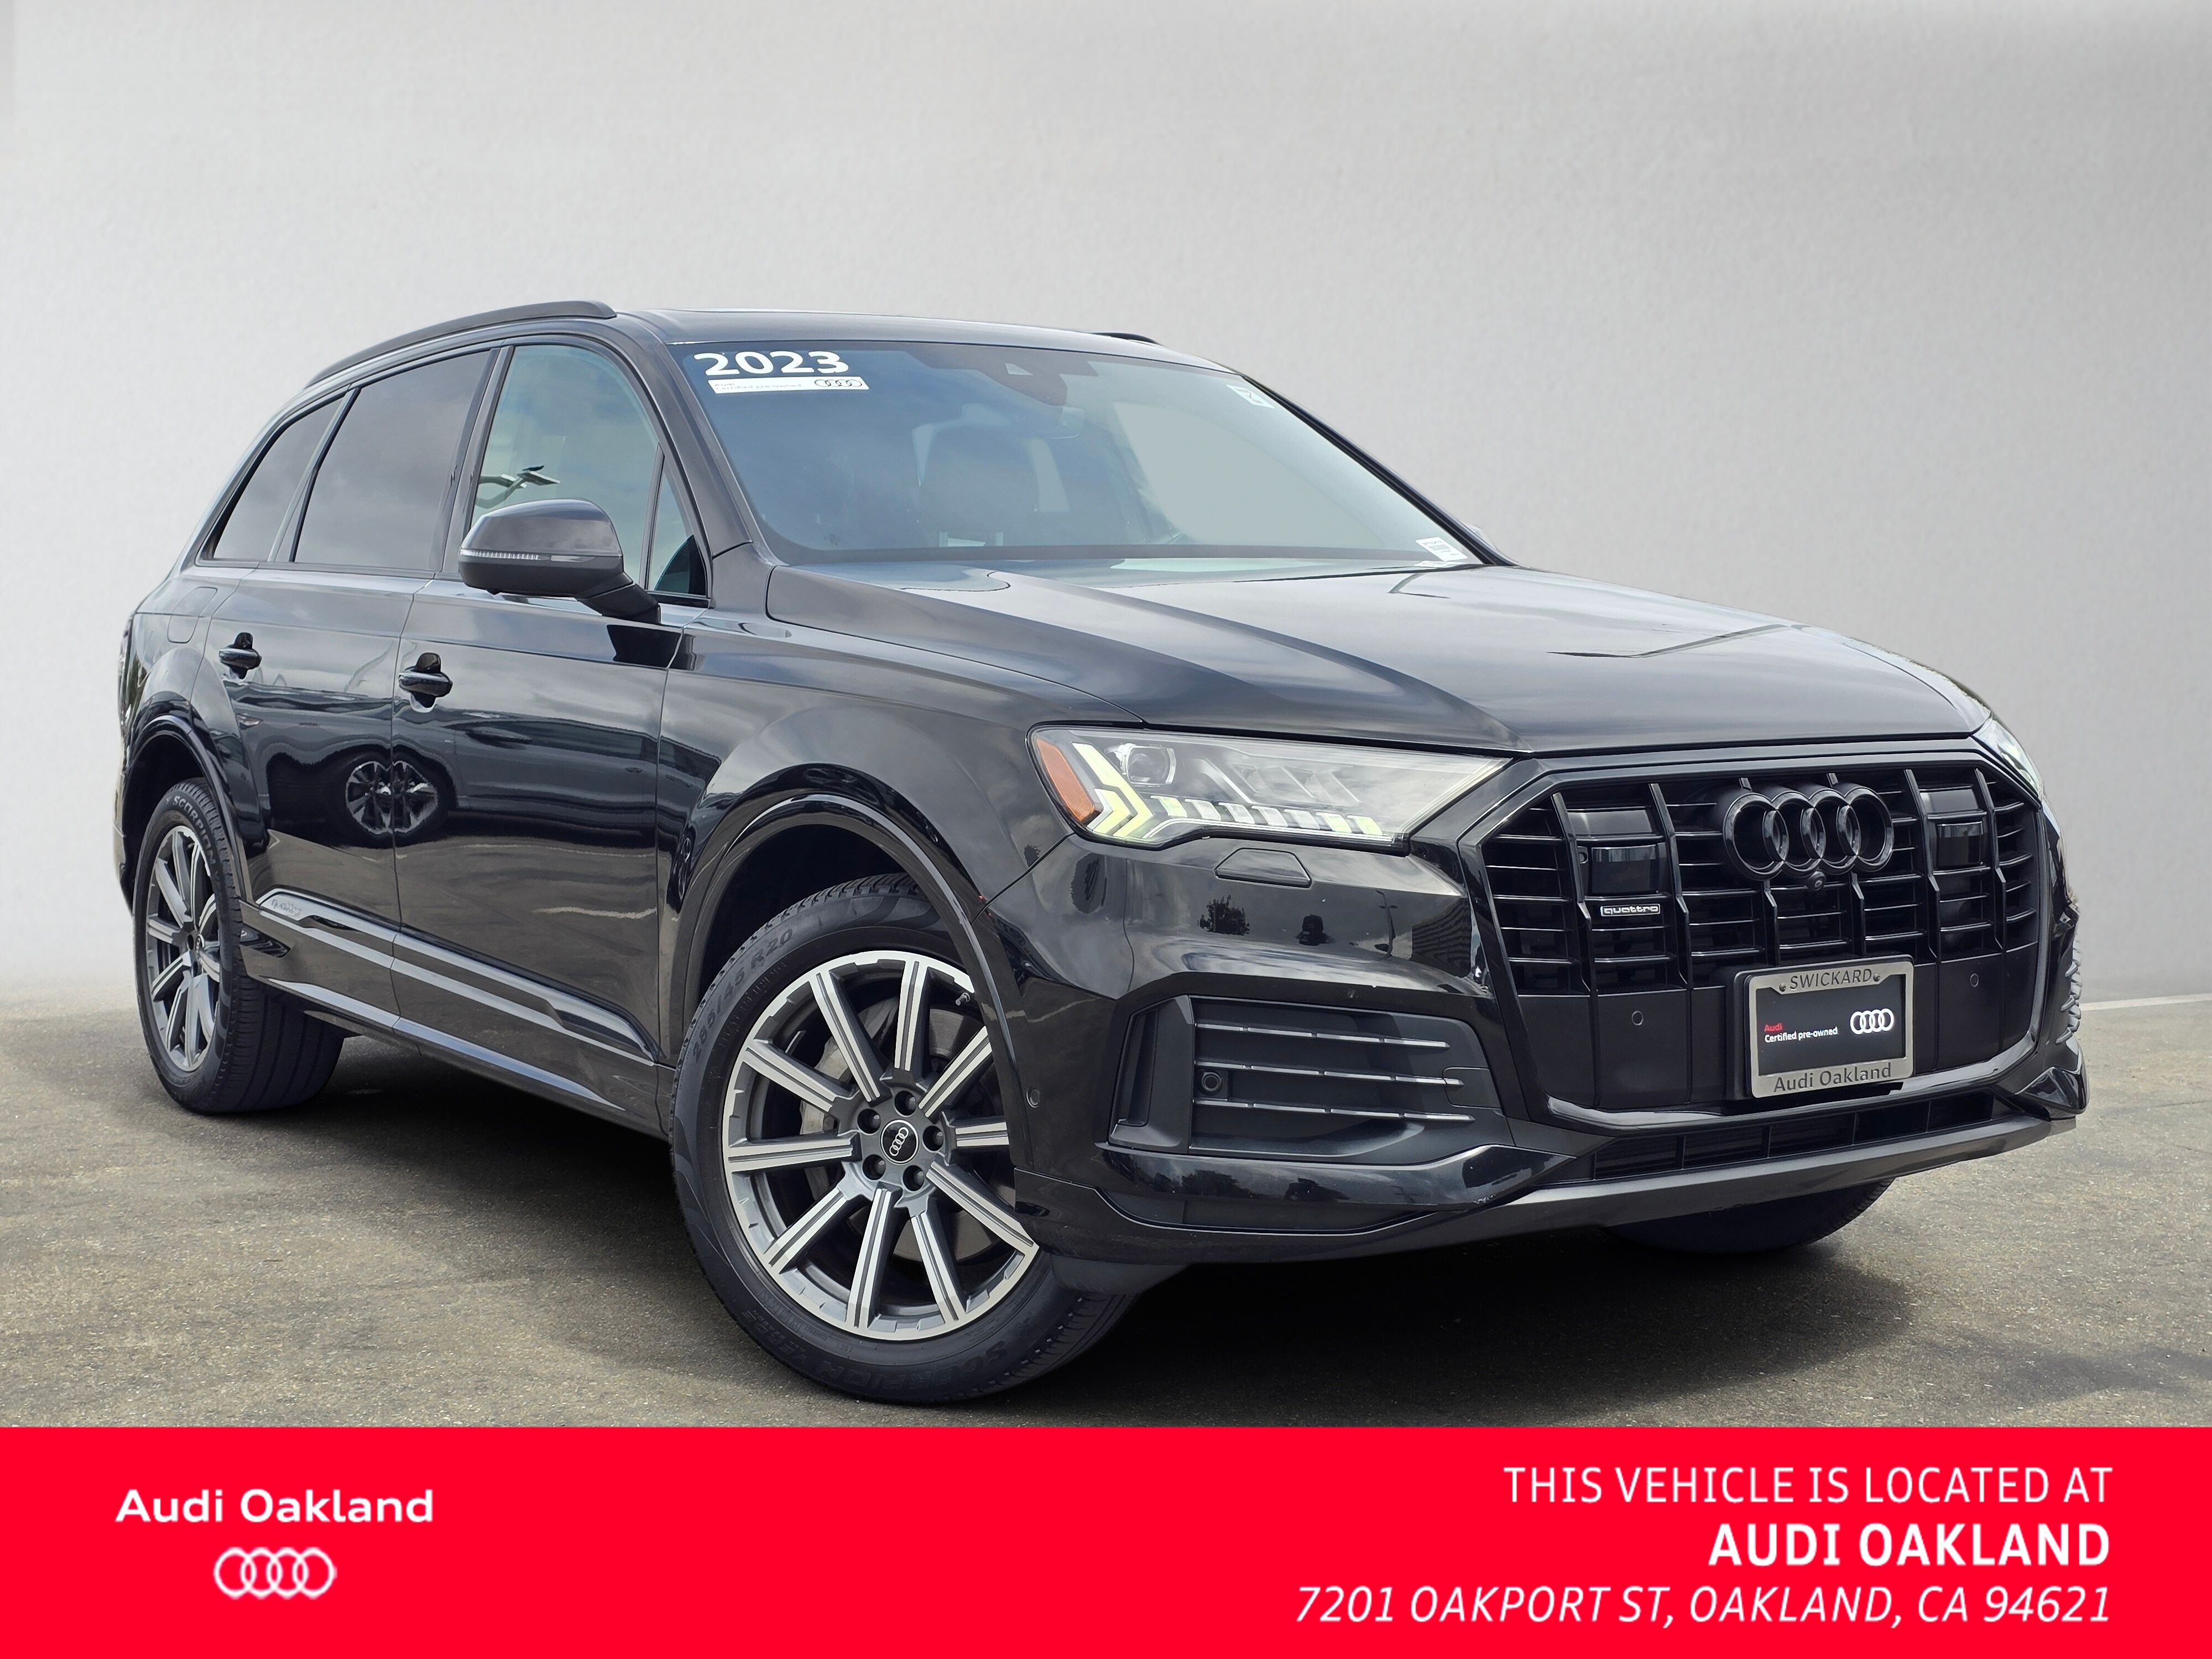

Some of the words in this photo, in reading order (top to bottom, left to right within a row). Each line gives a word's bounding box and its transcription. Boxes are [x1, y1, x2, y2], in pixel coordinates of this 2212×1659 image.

[693, 351, 849, 375] 2023
[173, 795, 216, 864] SCORPION
[1604, 906, 1658, 915] quattro
[1790, 968, 1872, 990] SWICKARD
[692, 966, 745, 1063] 285/45
[1764, 1023, 1782, 1032] Audi
[1765, 1032, 1797, 1043] Certified
[1798, 1026, 1838, 1041] pre-owned
[1773, 1072, 1814, 1093] Audi
[1819, 1062, 1891, 1086] Oakland
